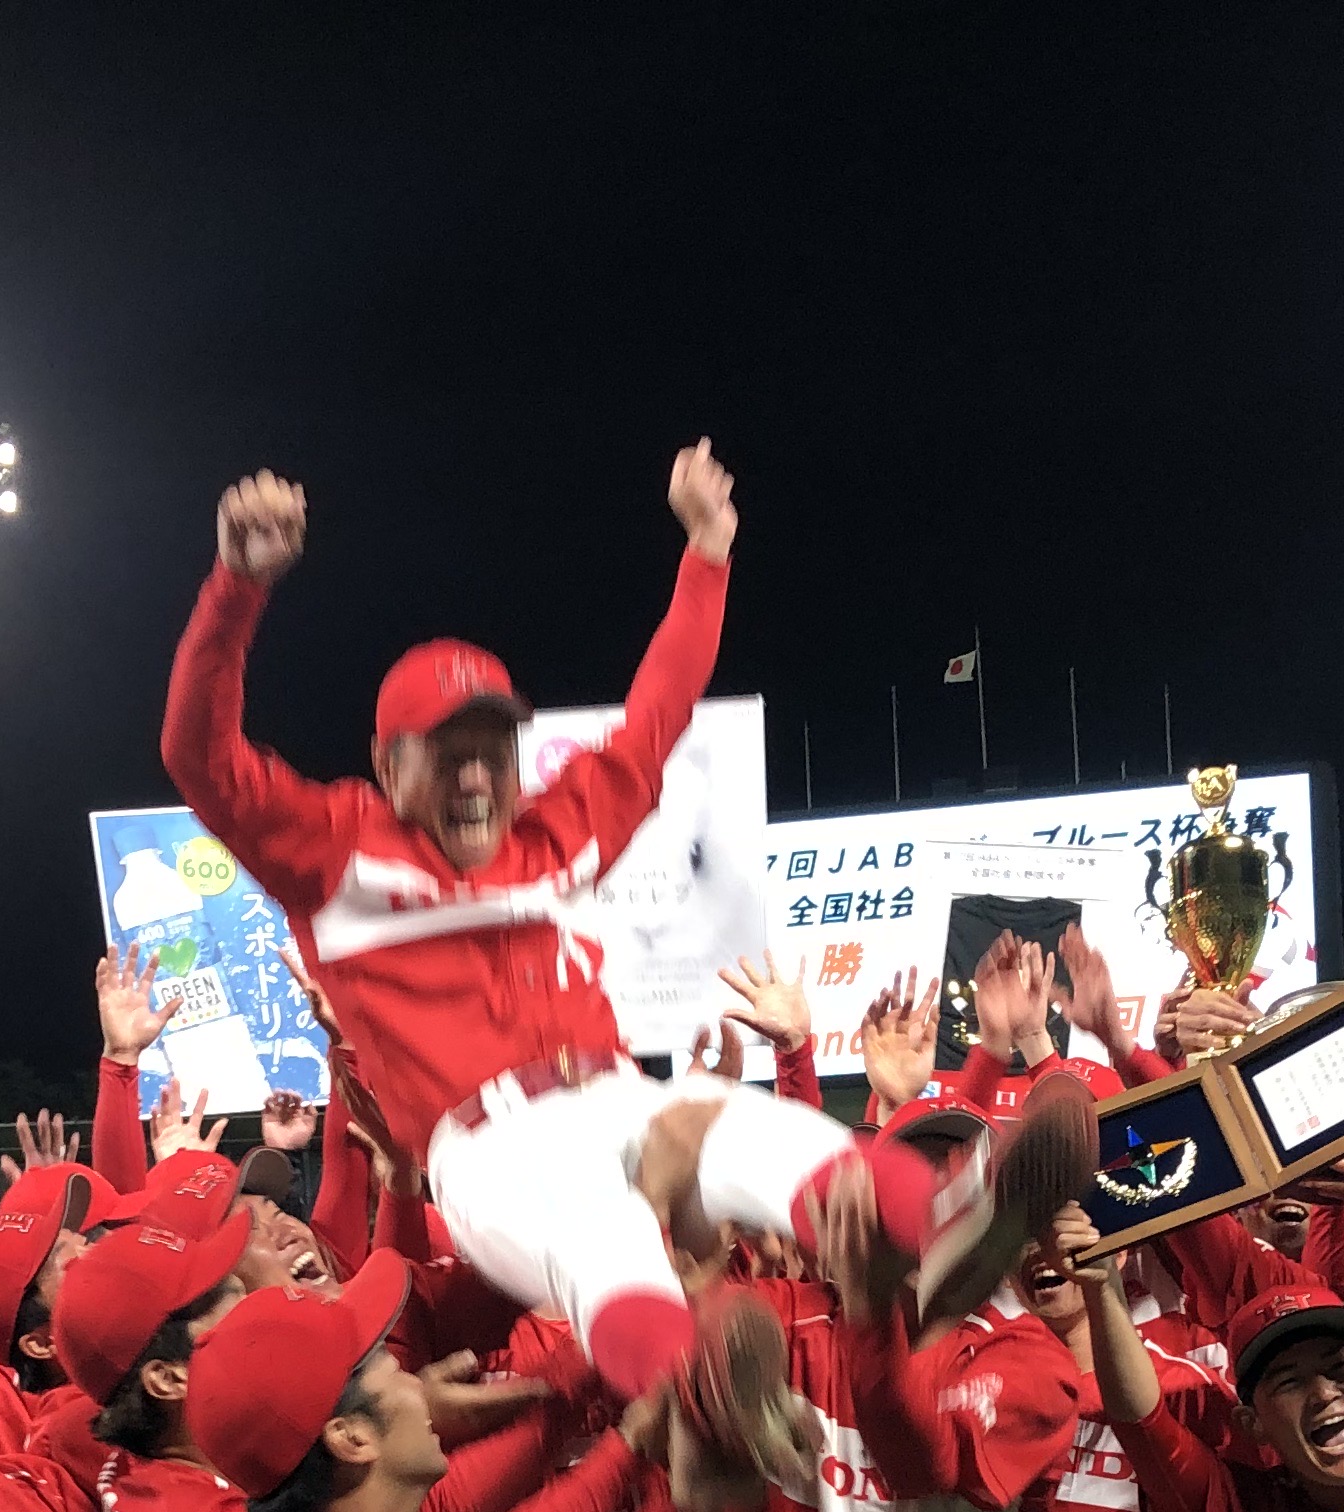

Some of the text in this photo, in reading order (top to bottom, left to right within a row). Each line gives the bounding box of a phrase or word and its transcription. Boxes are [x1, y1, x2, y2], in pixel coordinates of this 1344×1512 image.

[182, 859, 230, 880] 600
[786, 886, 914, 928] 全国社会
[816, 941, 865, 986] 勝
[160, 974, 216, 1002] GREEN
